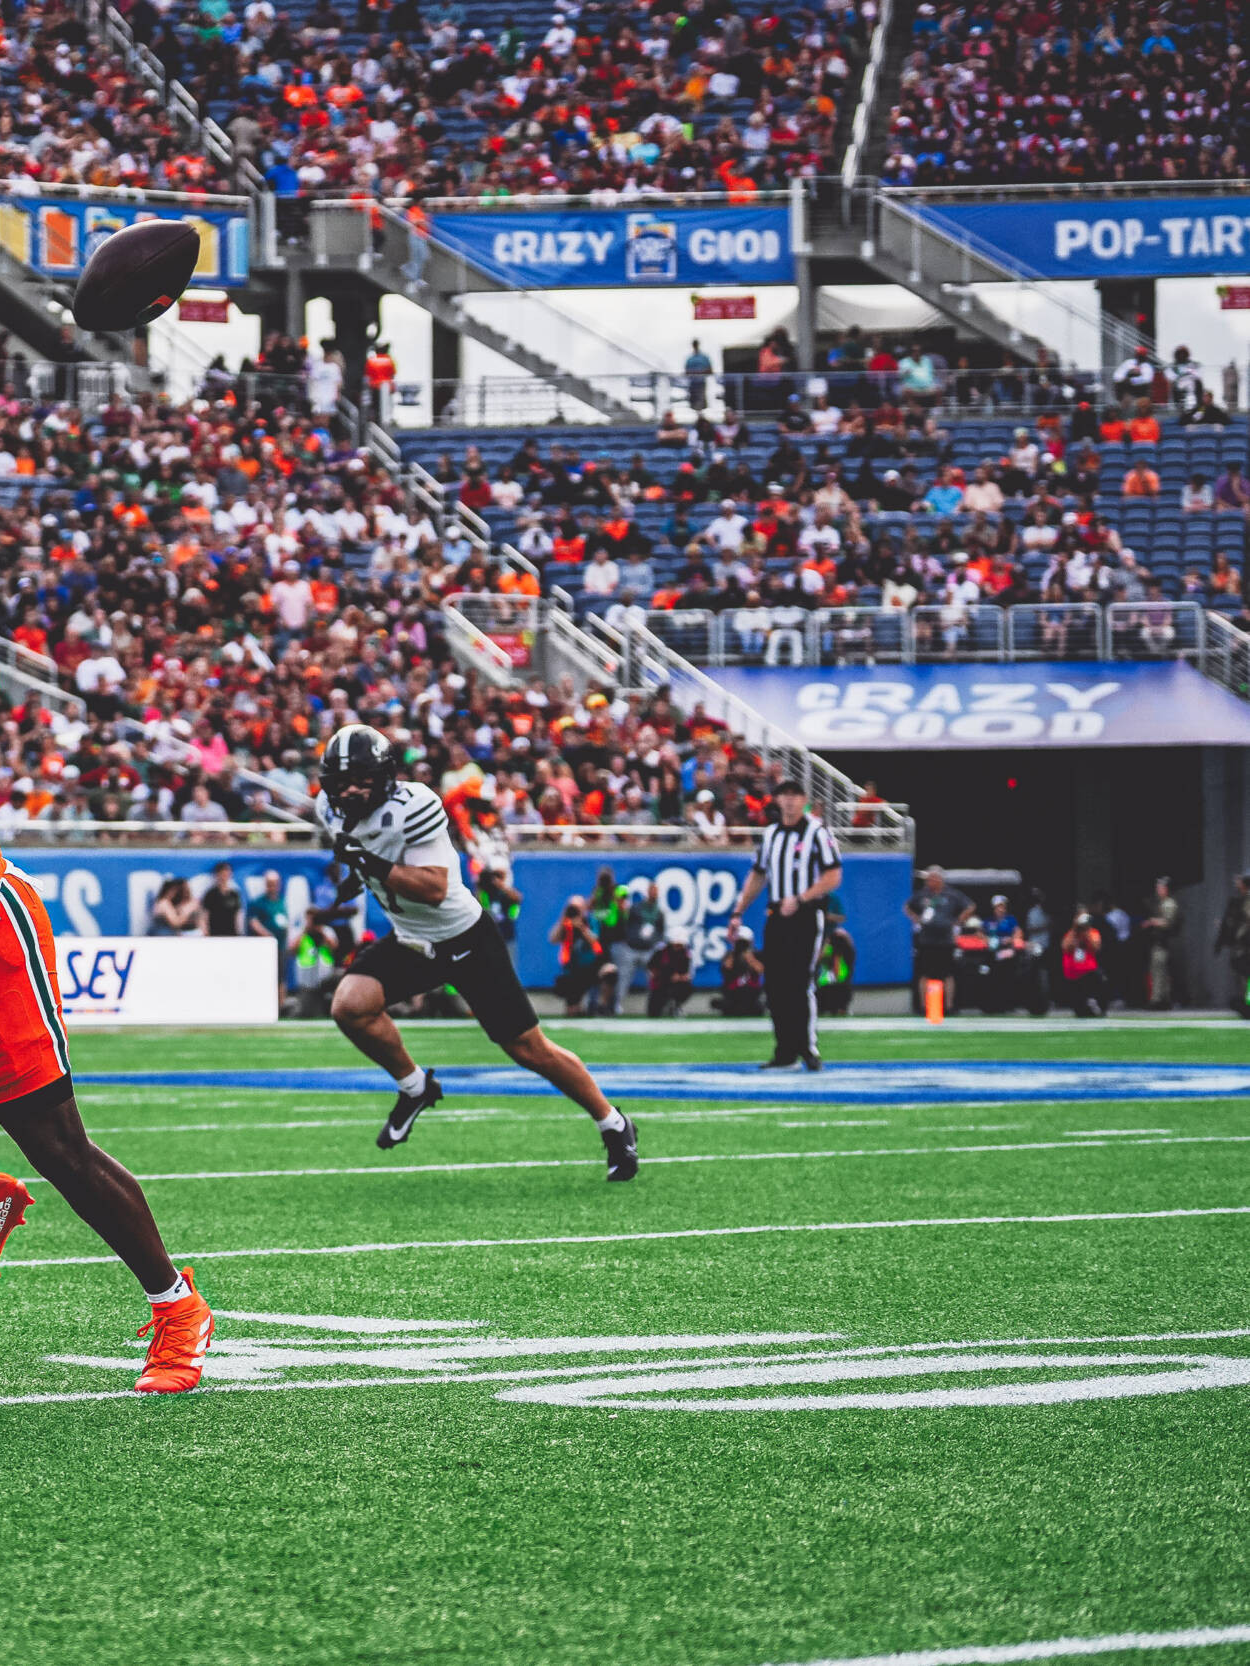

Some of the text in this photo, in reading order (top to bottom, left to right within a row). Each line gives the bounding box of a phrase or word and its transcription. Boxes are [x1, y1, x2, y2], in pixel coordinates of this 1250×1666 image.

[493, 231, 614, 265] CRAZY
[1054, 216, 1250, 260] POP-TAR
[795, 681, 1121, 714] CRAZY
[796, 708, 1106, 740] GOOD
[63, 950, 134, 1000] SEY
